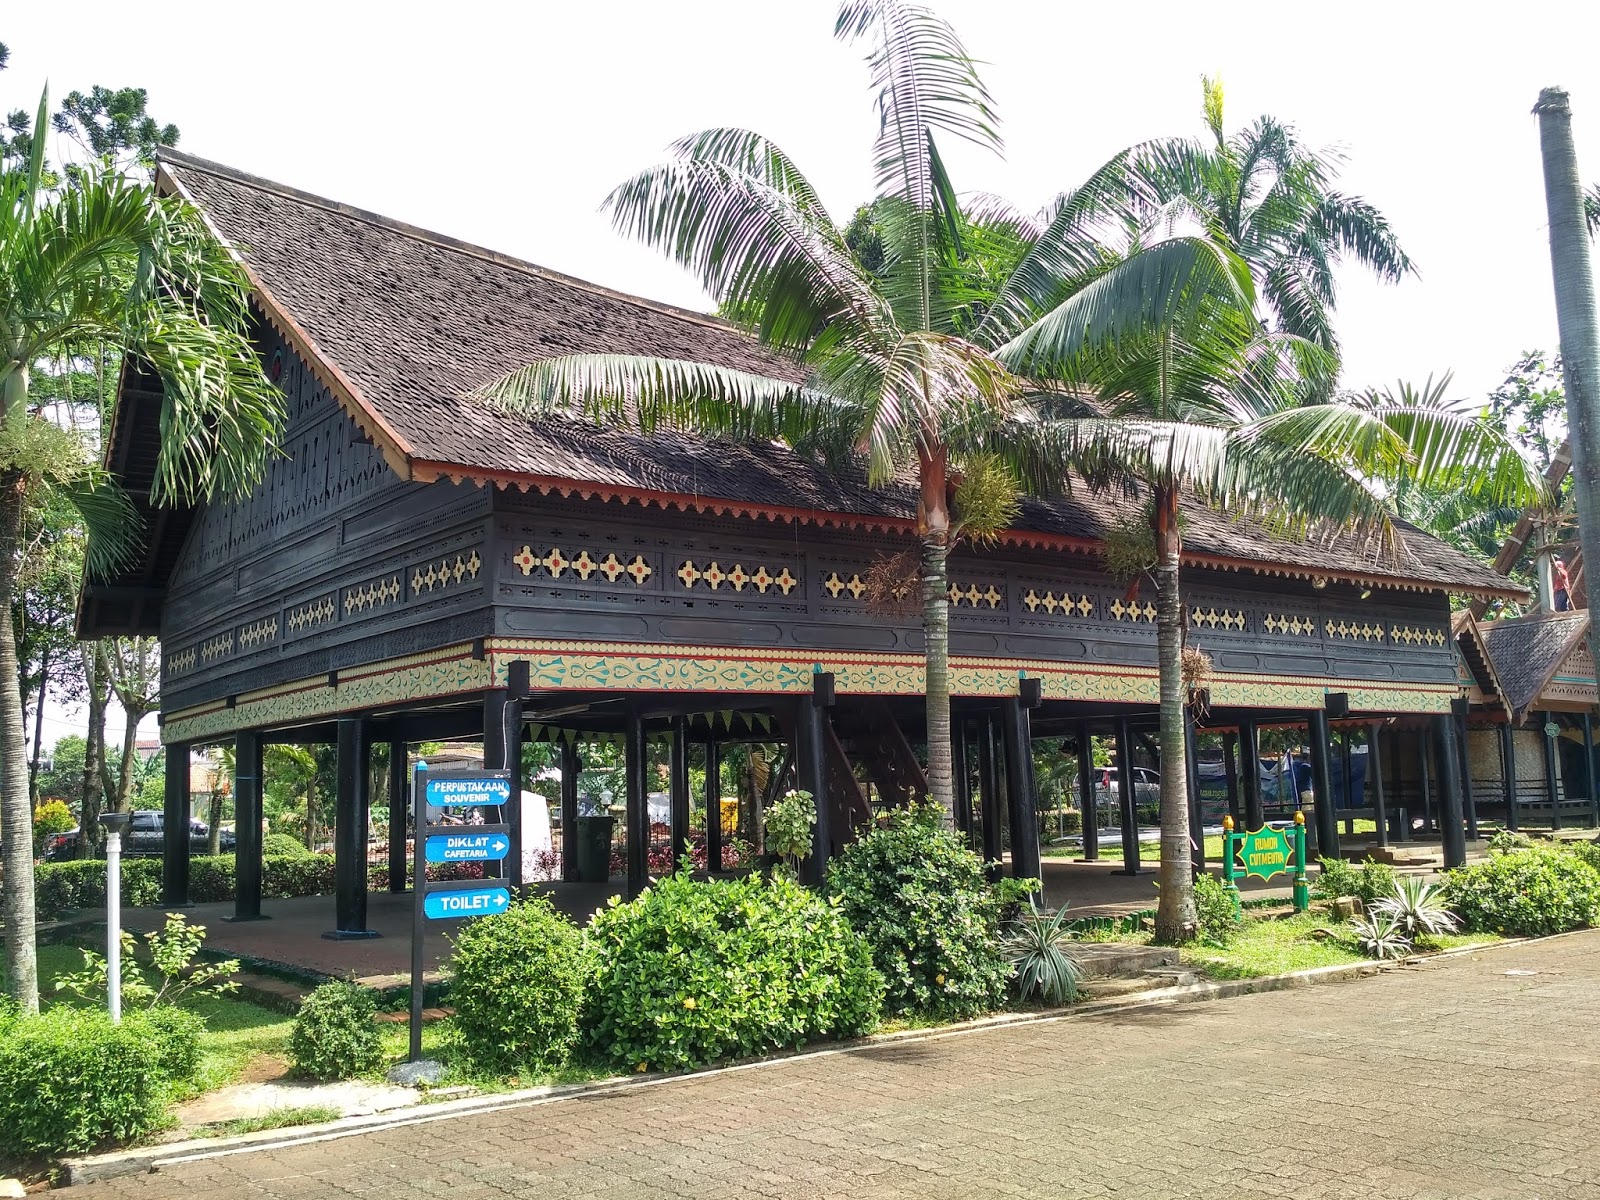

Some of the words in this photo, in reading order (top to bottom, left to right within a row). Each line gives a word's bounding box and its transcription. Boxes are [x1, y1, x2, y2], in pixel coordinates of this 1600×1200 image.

[434, 782, 504, 792] PERPUSTAKAAN
[444, 793, 489, 803] SOUVENIR
[447, 837, 489, 847] DIKLAT
[444, 850, 488, 858] CAFETARIA
[441, 895, 491, 910] TOILET
